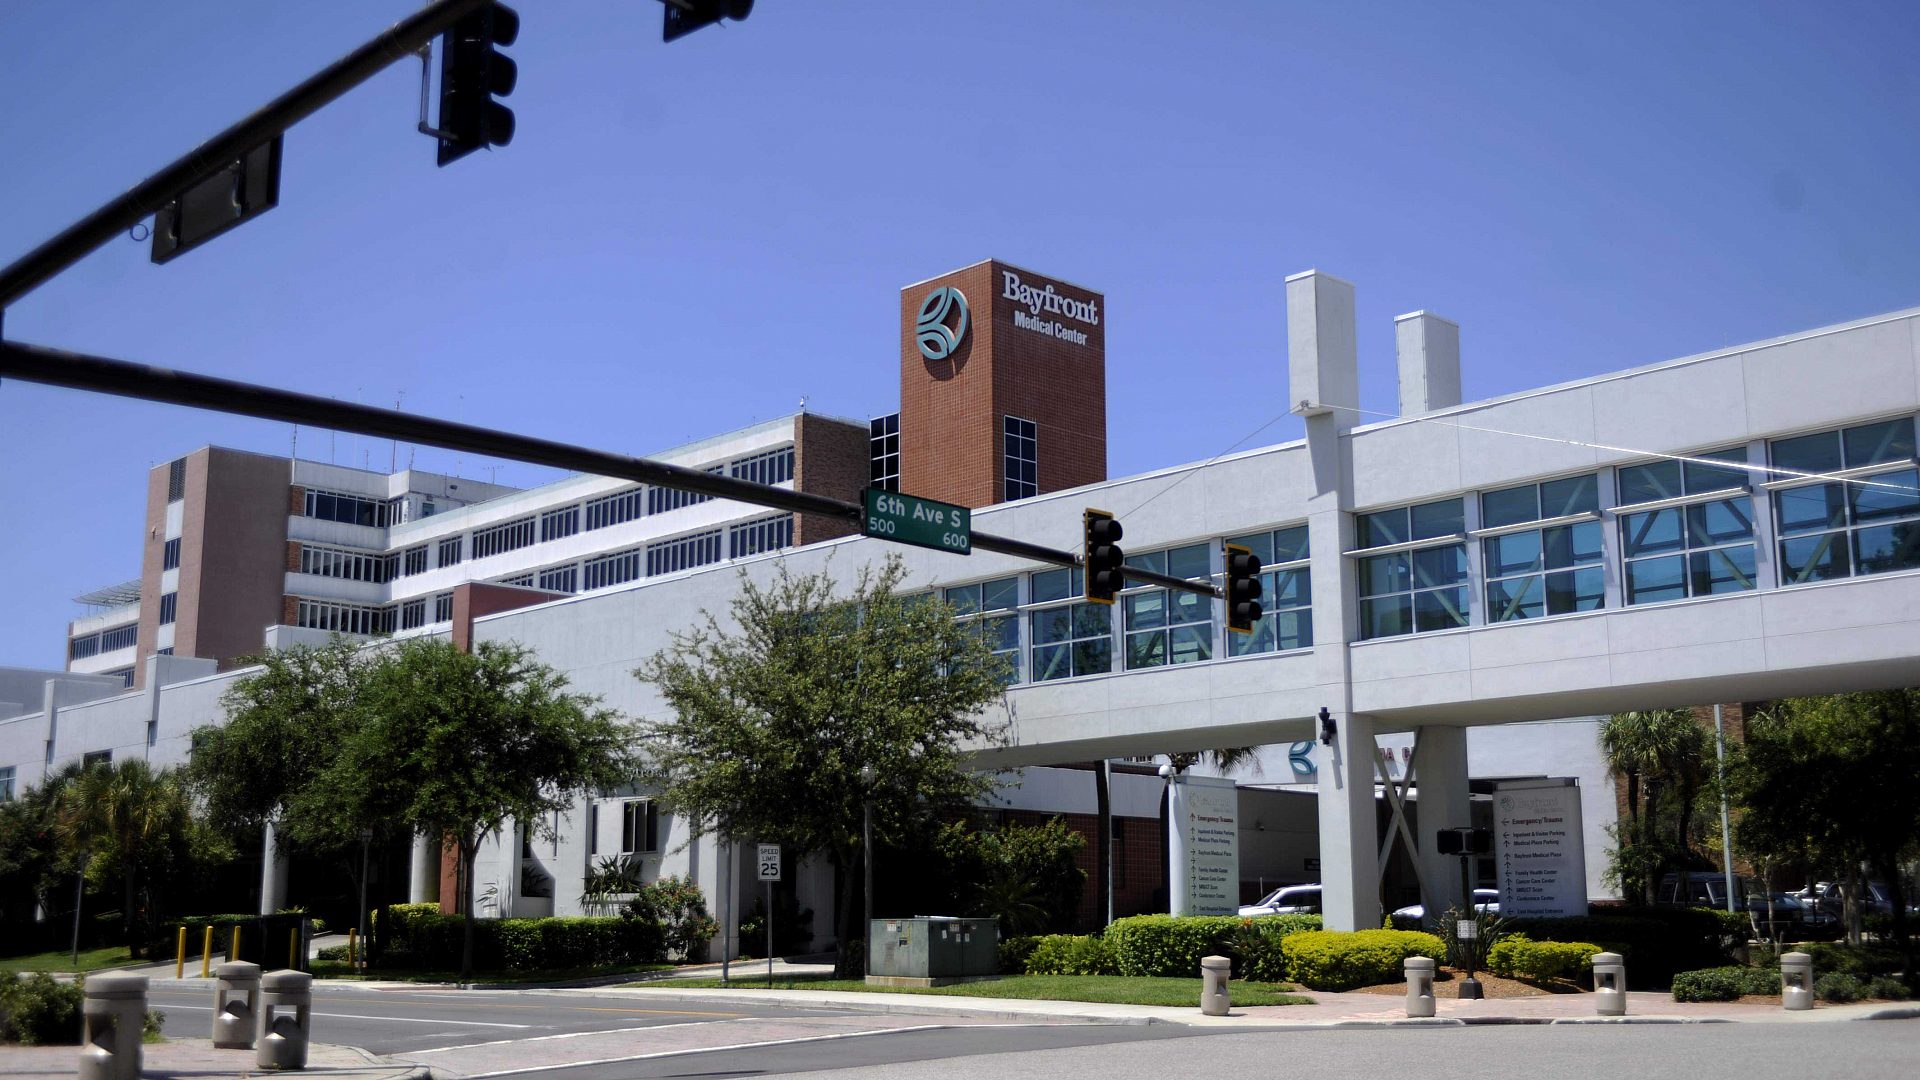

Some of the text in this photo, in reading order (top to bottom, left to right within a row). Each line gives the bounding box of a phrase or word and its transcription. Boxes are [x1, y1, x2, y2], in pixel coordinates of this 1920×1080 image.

[1002, 270, 1098, 326] Bayfront
[1014, 310, 1087, 346] Medical Center
[876, 495, 961, 528] 6th Ave S
[870, 517, 896, 534] 500
[943, 532, 967, 548] 600
[761, 863, 779, 876] 25
